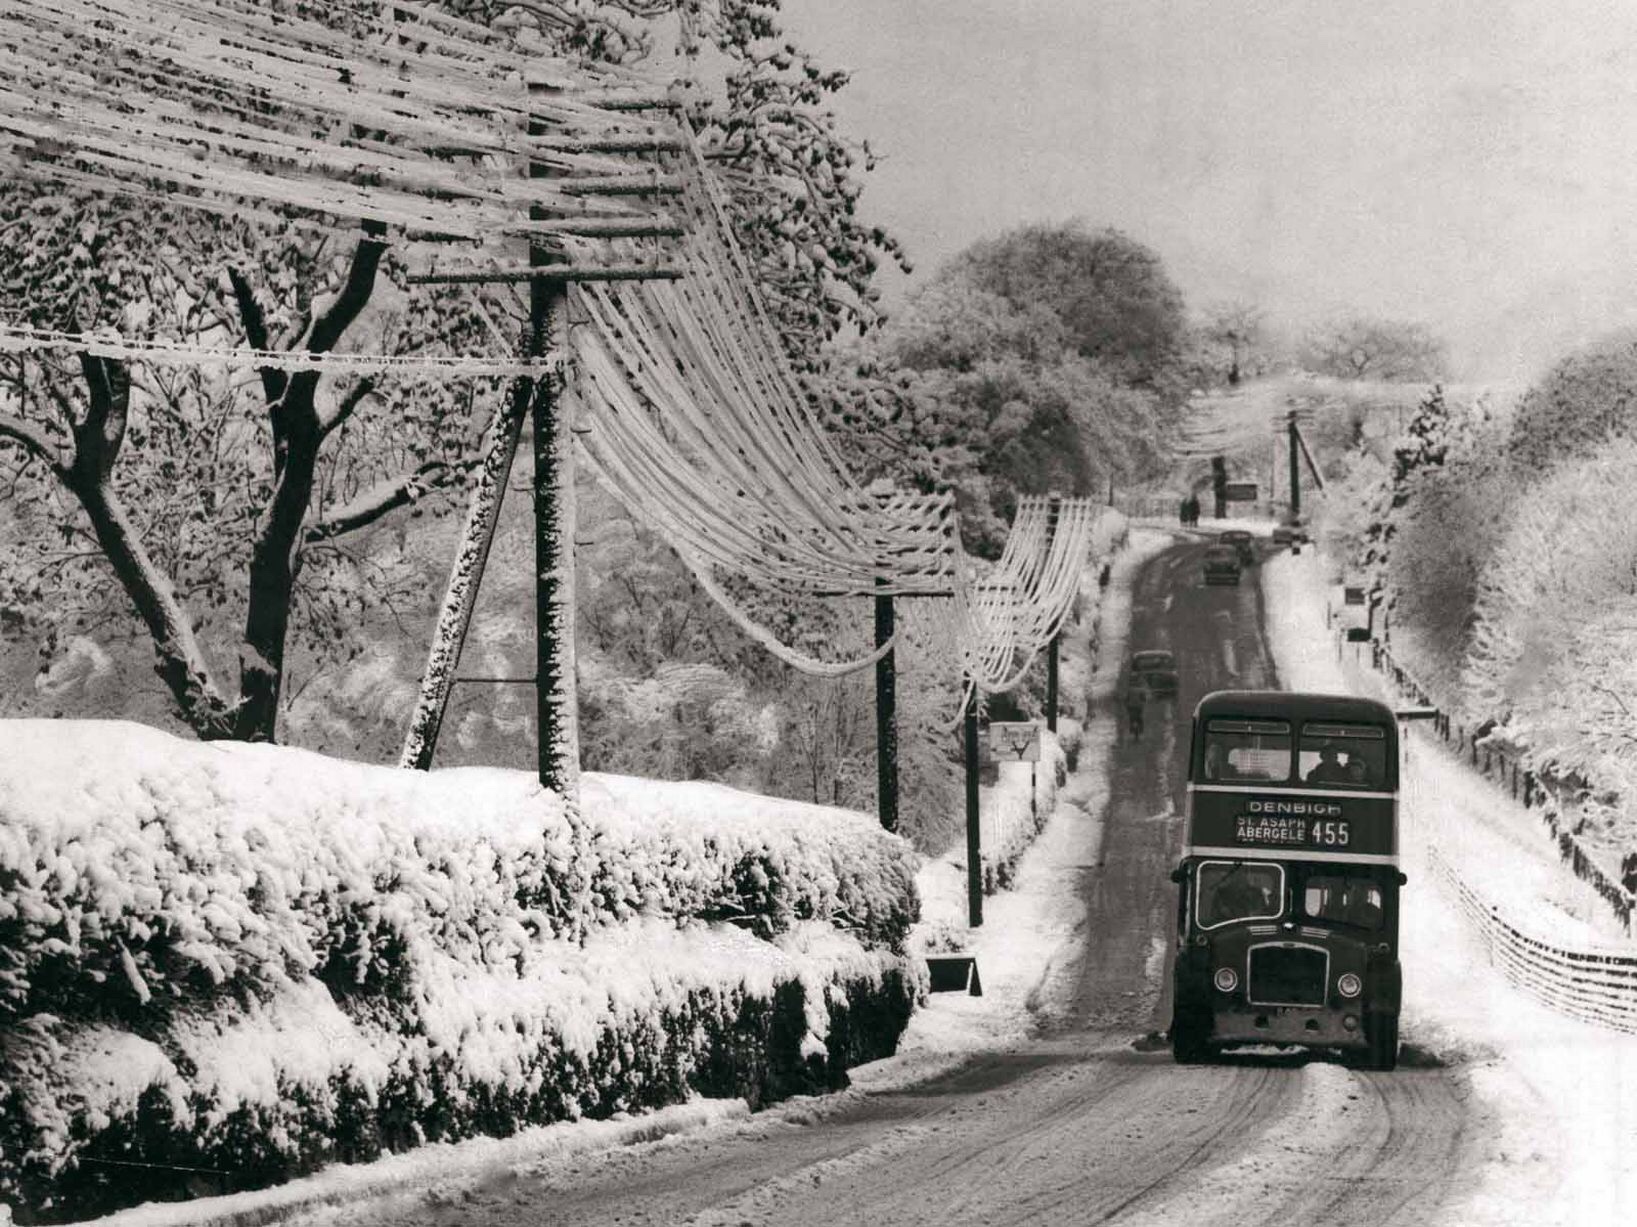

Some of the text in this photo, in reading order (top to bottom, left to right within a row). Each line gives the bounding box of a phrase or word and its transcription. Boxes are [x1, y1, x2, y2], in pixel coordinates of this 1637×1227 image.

[1249, 801, 1341, 814] DENBIGH
[1237, 827, 1305, 841] ABERGELE
[1312, 821, 1349, 845] 455
